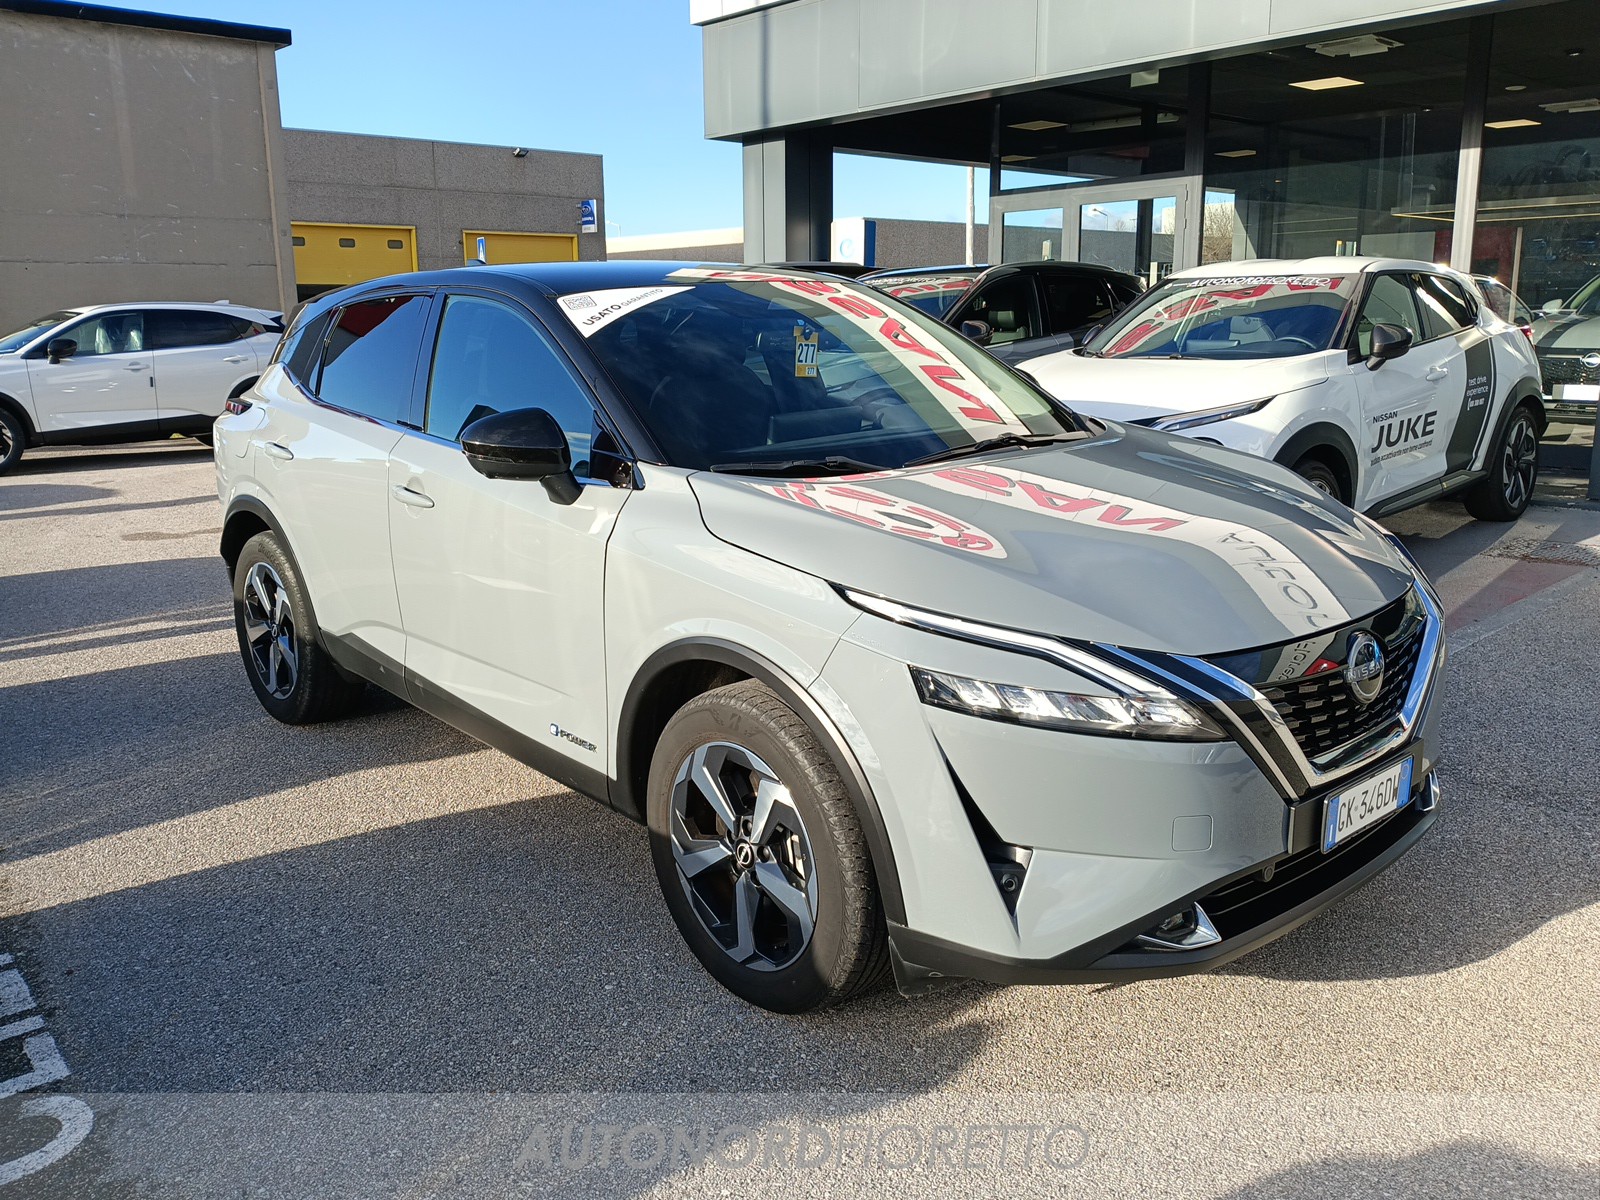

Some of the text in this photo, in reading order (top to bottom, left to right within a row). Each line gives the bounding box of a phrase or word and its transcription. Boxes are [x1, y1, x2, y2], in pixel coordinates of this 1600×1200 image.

[582, 288, 664, 327] USATO GARANTITO
[797, 343, 817, 363] 277
[1371, 410, 1438, 453] JUKE
[1372, 411, 1398, 424] NISSAN
[1338, 796, 1356, 832] GK
